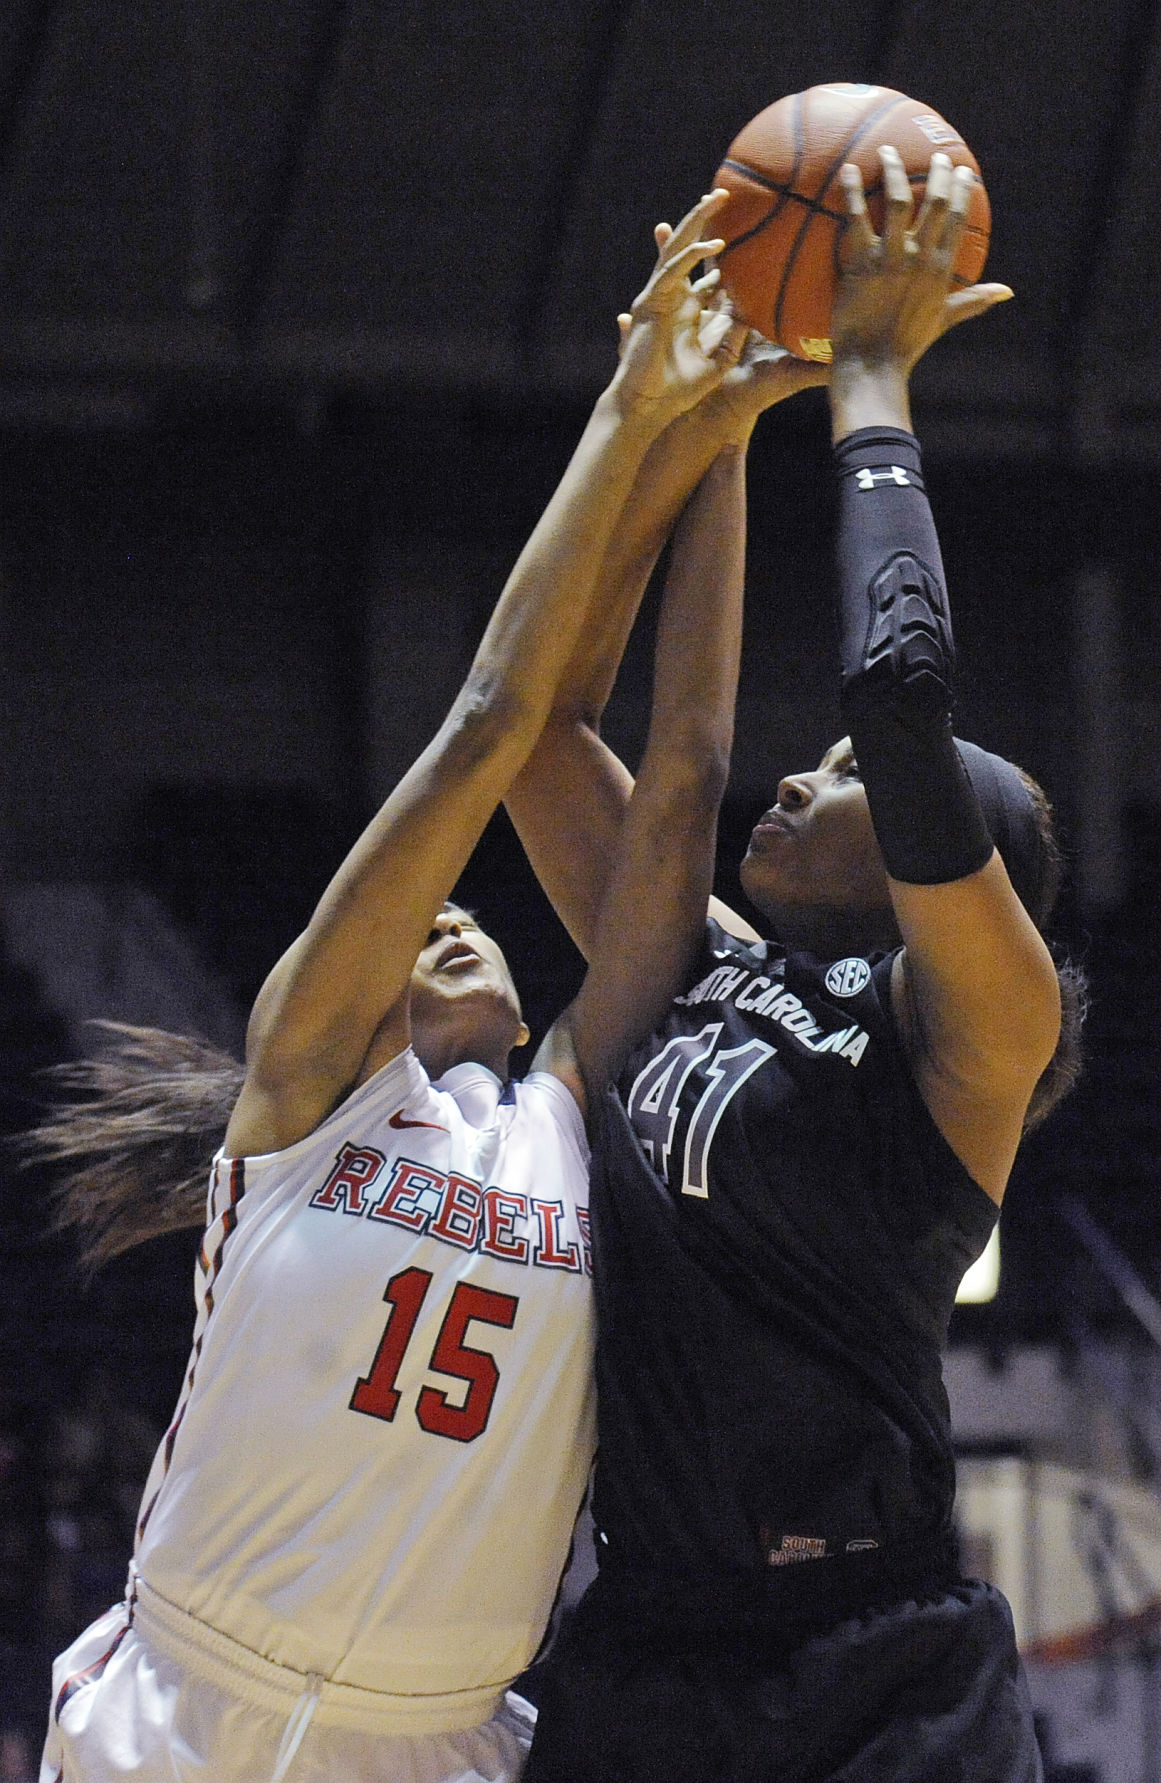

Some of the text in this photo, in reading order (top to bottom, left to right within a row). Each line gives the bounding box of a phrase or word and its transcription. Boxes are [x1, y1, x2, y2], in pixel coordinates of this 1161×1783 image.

[829, 958, 868, 995] SEC
[627, 1022, 778, 1199] 41
[349, 1266, 520, 1443] 15
[781, 1536, 826, 1554] SOUTH
